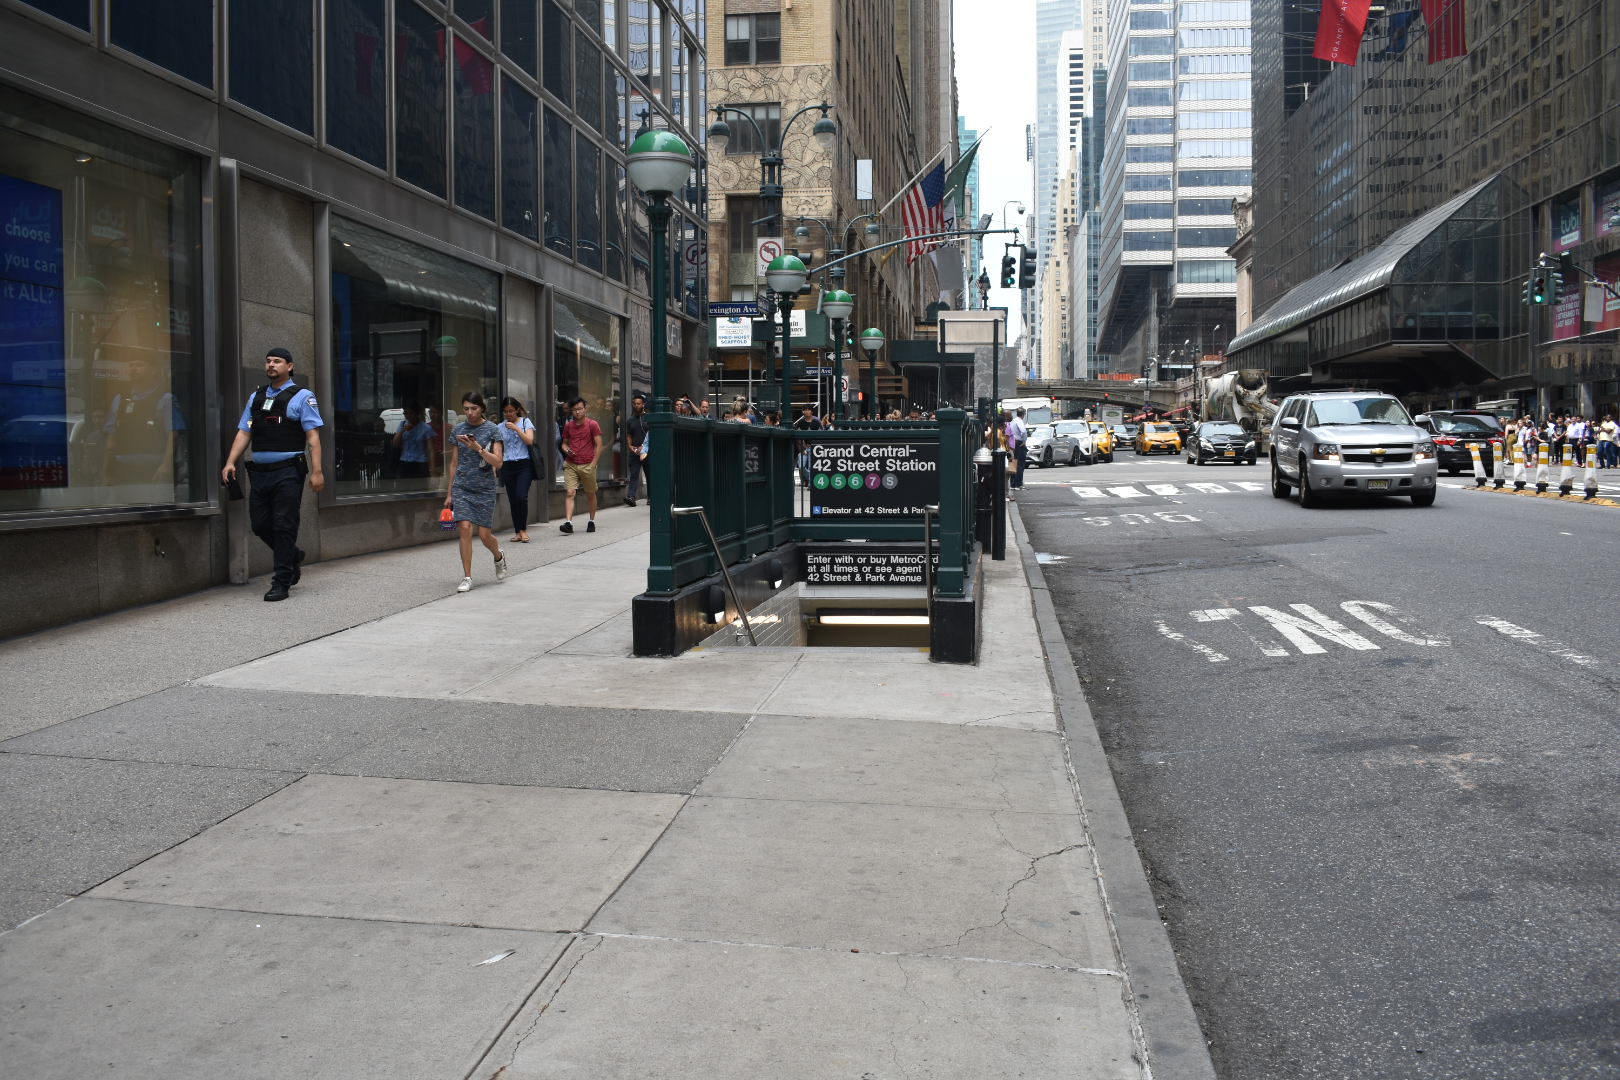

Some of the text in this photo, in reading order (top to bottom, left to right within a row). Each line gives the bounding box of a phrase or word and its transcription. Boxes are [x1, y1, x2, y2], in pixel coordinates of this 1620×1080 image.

[1561, 210, 1579, 234] tubi
[5, 216, 51, 243] choose
[4, 253, 57, 273] you can
[4, 280, 54, 304] it ALL?
[709, 306, 741, 314] exington
[743, 305, 757, 313] Ave
[813, 445, 917, 458] Grand Central-
[813, 459, 936, 471] 42 Street Station
[1081, 510, 1201, 527] BUS
[807, 556, 831, 564] Enter
[835, 556, 853, 564] with
[870, 556, 887, 565] buy
[891, 556, 939, 564] MetroCd
[807, 565, 816, 573] at
[820, 565, 830, 573] all
[834, 565, 859, 573] times
[896, 565, 922, 574] agent
[807, 574, 922, 582] 42 Street & Park Avenue
